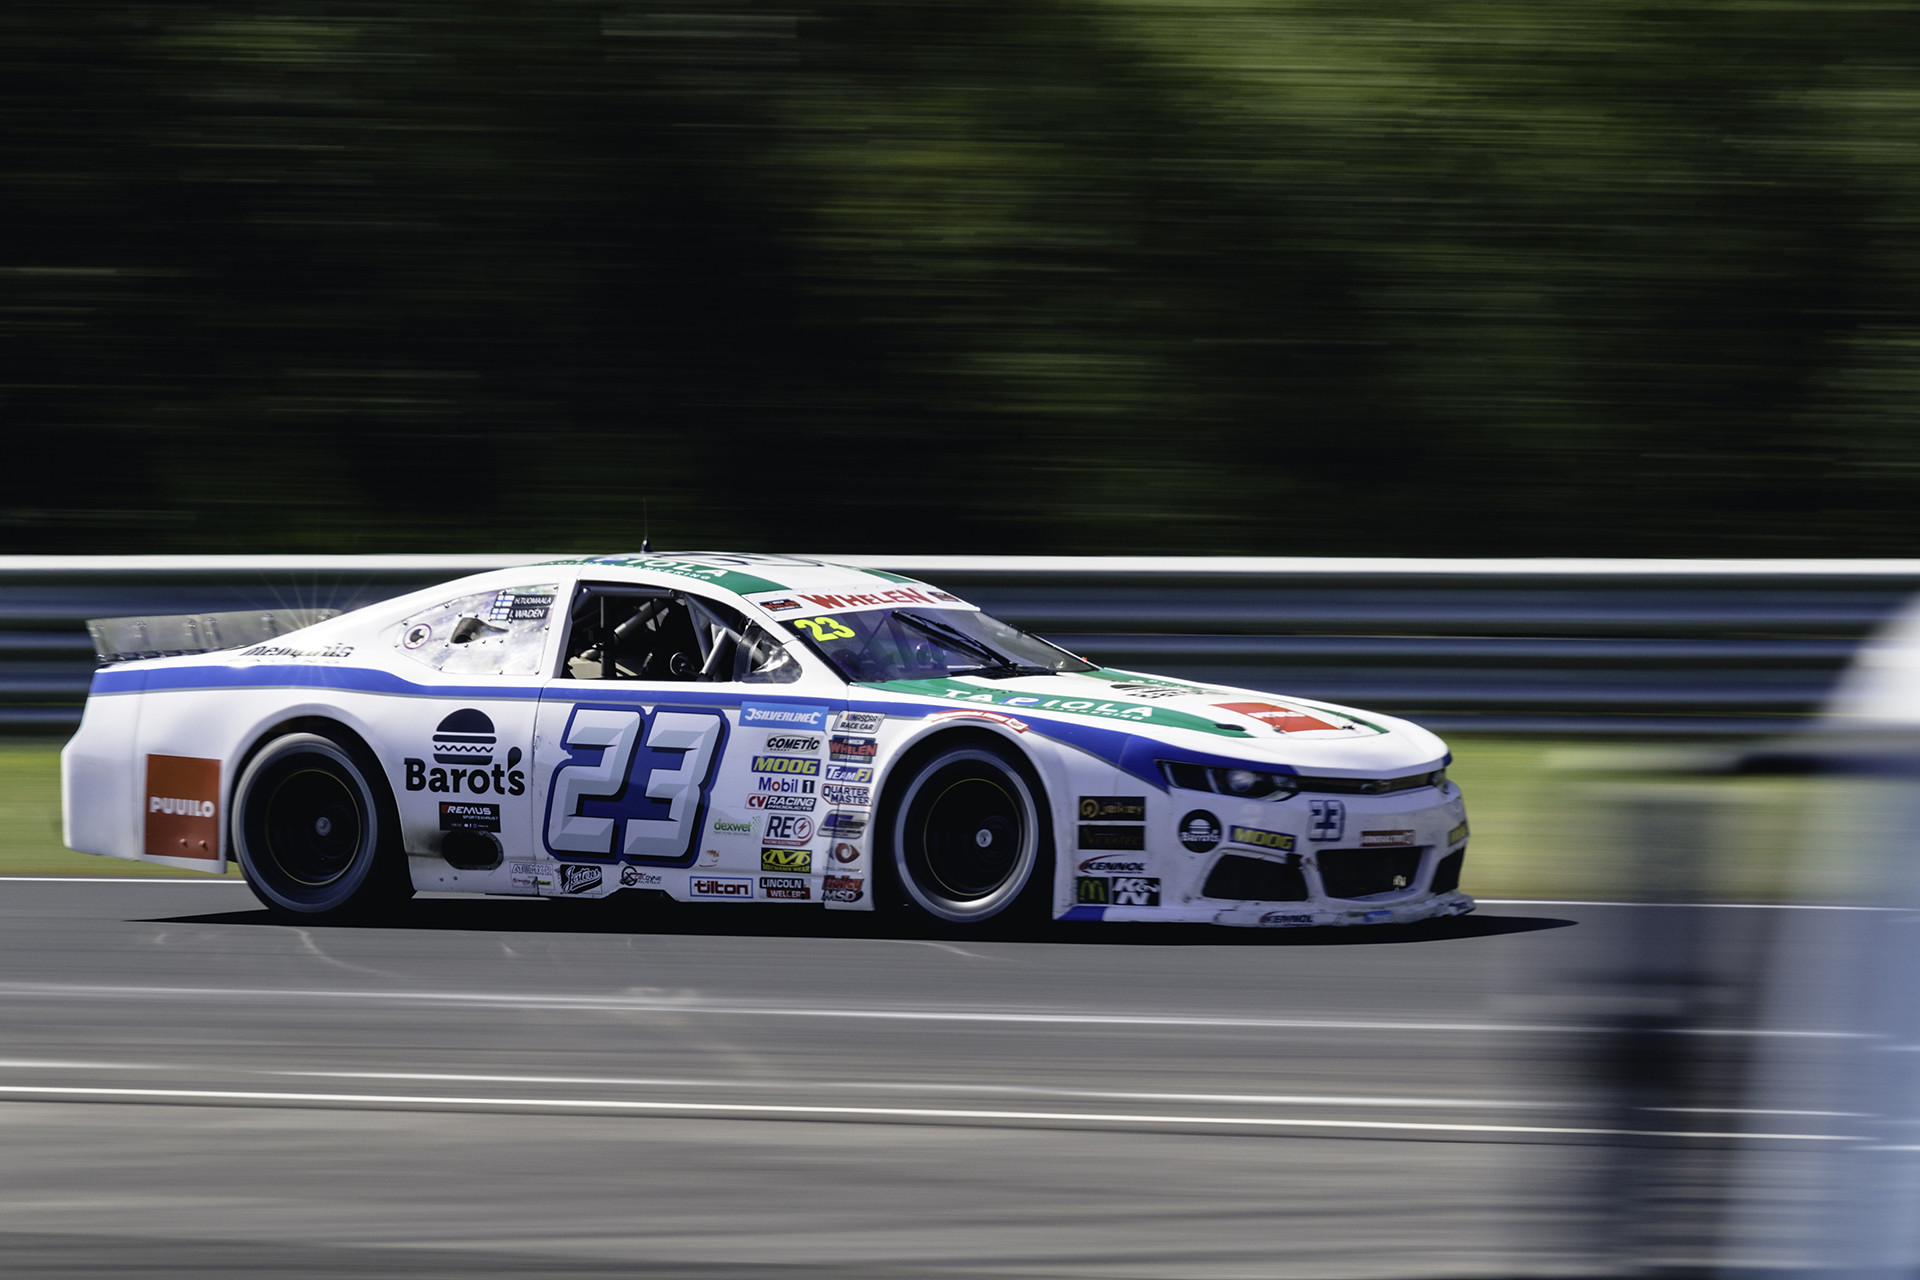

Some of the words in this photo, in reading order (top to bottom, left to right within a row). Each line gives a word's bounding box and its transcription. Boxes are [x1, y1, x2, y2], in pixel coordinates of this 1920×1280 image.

[797, 587, 937, 609] WHELEN
[794, 617, 855, 641] 23
[945, 689, 1153, 717] TAPIOLA
[754, 711, 811, 722] SILVERLINE
[852, 713, 878, 721] NASCAR
[767, 737, 820, 750] COMETIC
[829, 740, 878, 756] WHELEN
[404, 747, 525, 796] Barot's
[753, 757, 818, 774] MOOG
[548, 709, 722, 860] 23
[759, 777, 798, 792] Mobil
[802, 780, 815, 793] 1
[823, 785, 869, 797] QUARTER
[748, 796, 766, 807] CV
[767, 797, 814, 806] RACING
[831, 794, 870, 804] MASTER
[149, 796, 215, 818] PUUILO
[447, 806, 491, 815] REMUS
[1308, 800, 1344, 841] 23
[1232, 828, 1293, 849] MOOG
[793, 865, 810, 873] WEAR
[695, 880, 749, 895] tilton
[761, 879, 802, 888] LINCOLN
[821, 889, 857, 902] MSD
